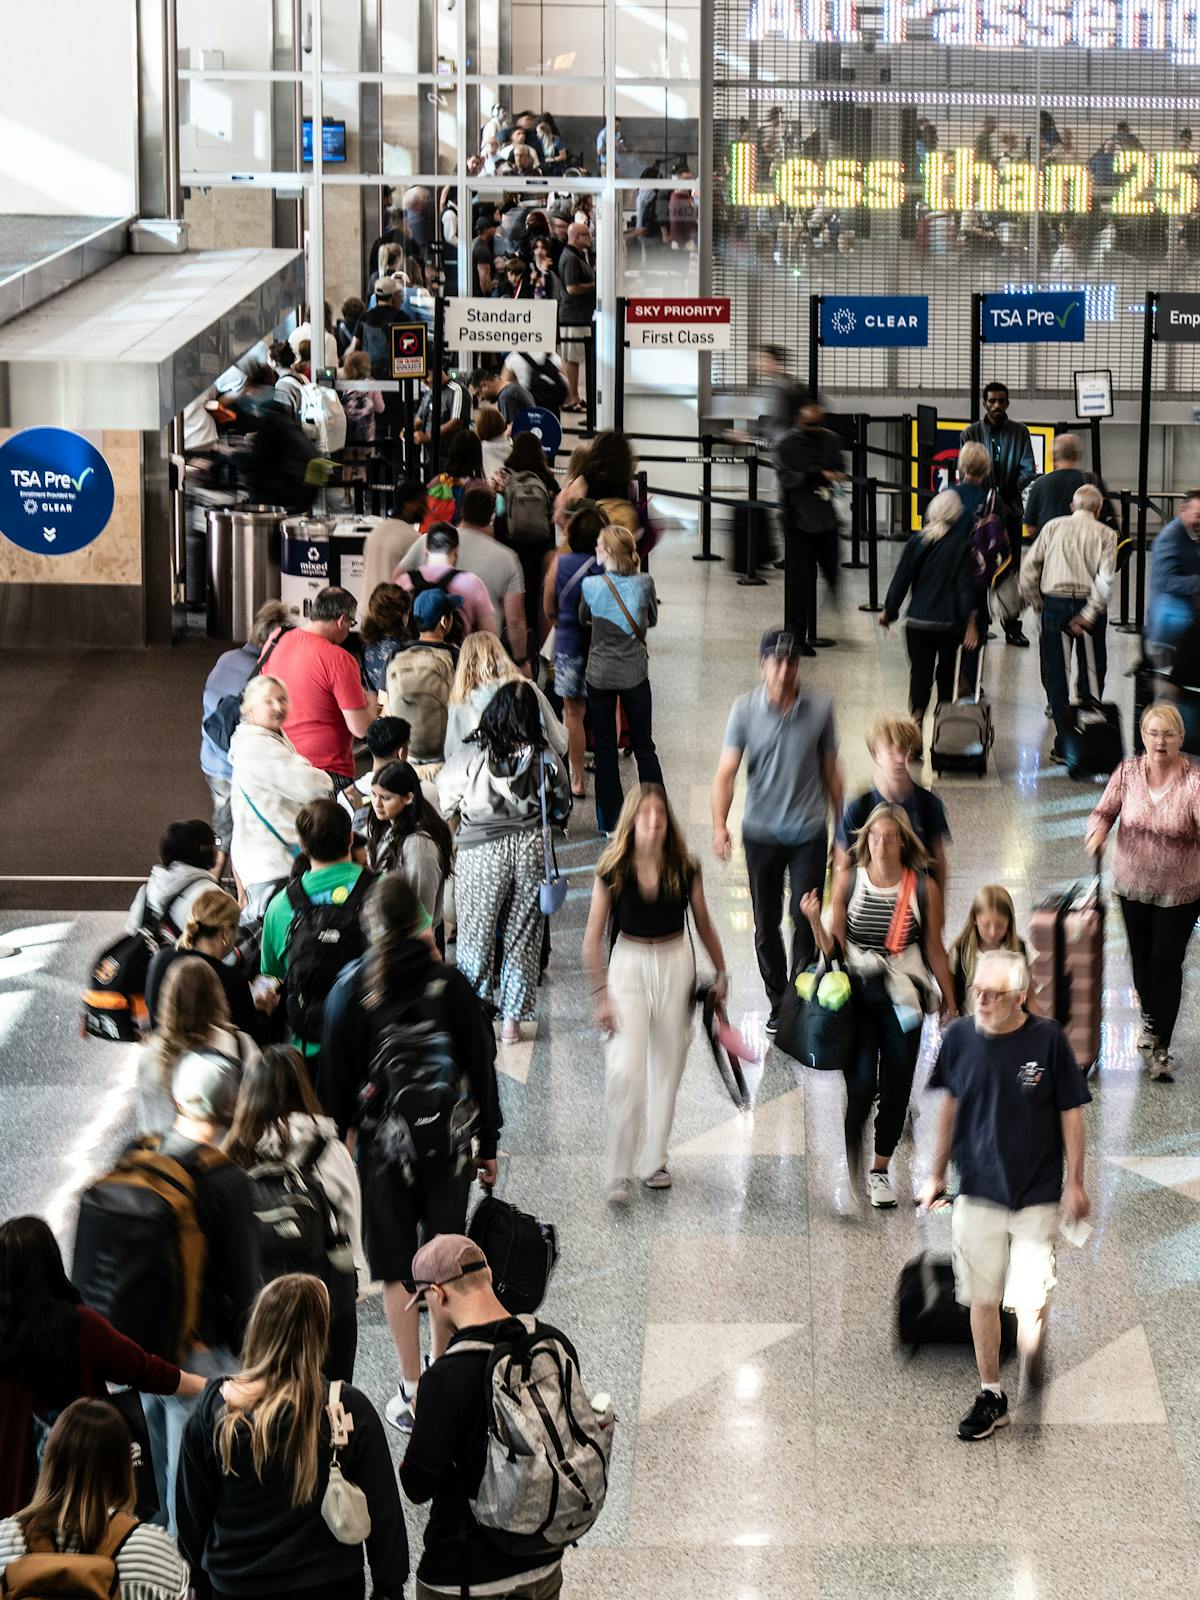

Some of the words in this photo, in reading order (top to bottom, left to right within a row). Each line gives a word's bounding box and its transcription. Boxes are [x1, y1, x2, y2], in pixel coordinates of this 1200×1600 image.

[731, 142, 906, 208] Less
[920, 147, 1092, 214] than
[1112, 150, 1199, 215] 25
[466, 308, 531, 324] Standard
[635, 306, 660, 317] SKY
[664, 306, 722, 317] PRIORITY
[990, 308, 1023, 327] TSA
[1028, 308, 1055, 327] Pre
[864, 315, 918, 328] CLEAR
[459, 327, 542, 345] Passengers
[642, 330, 673, 344] First
[677, 330, 715, 344] Class
[10, 469, 41, 488] TSA
[44, 470, 71, 489] Pre
[42, 502, 72, 512] CLEAR
[300, 561, 328, 571] mixed
